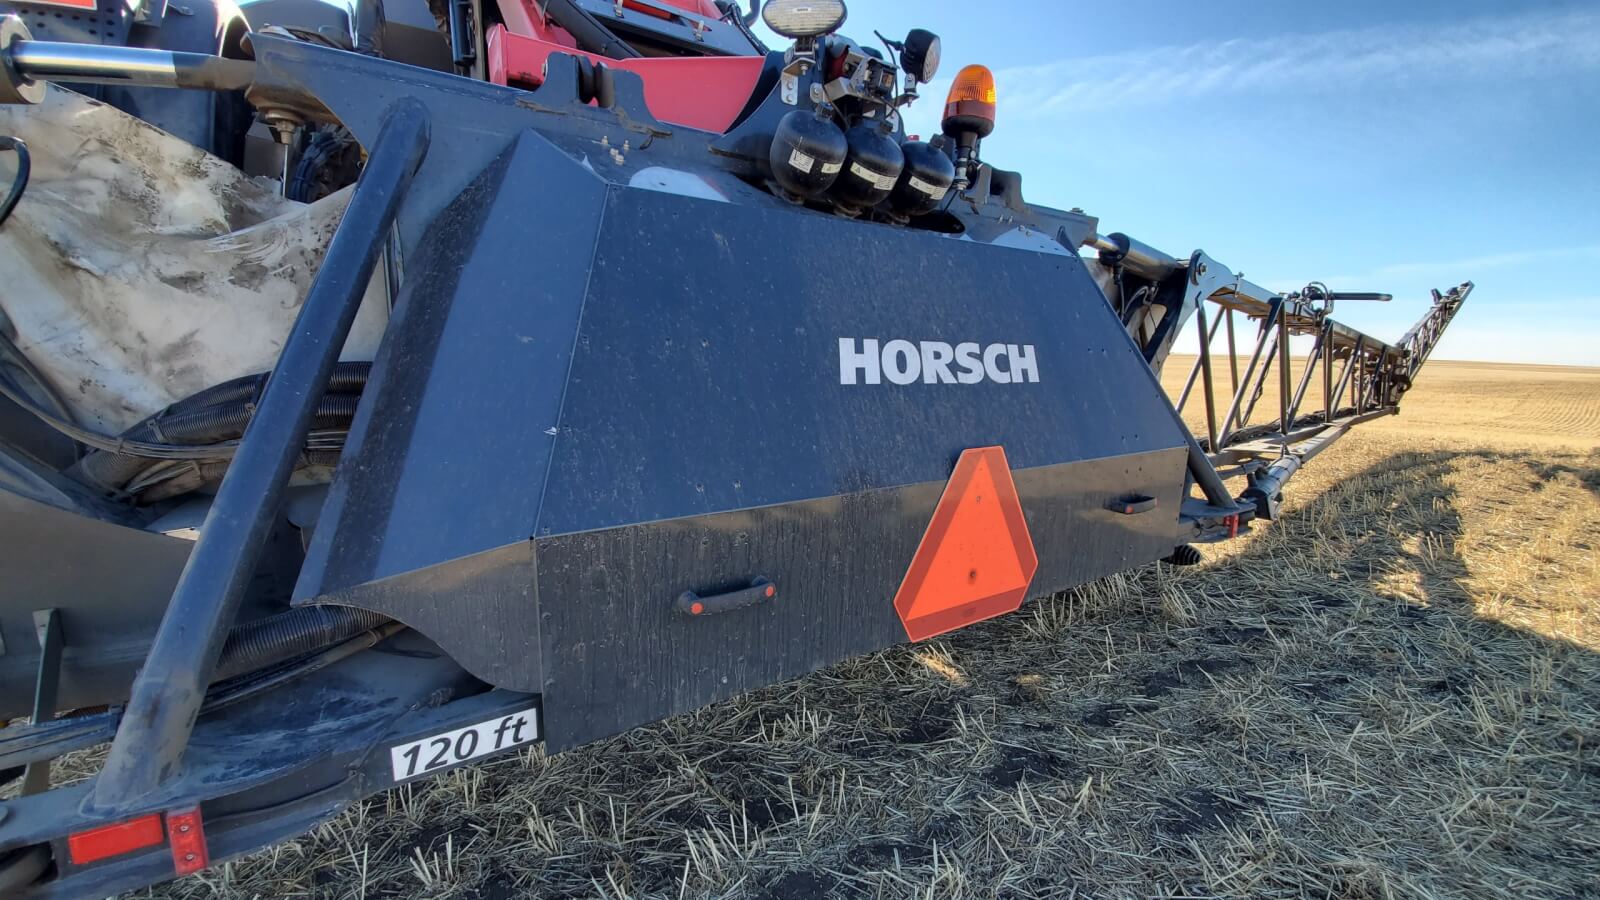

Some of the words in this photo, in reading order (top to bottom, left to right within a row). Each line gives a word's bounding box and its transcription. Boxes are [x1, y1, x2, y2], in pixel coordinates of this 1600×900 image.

[838, 337, 1040, 385] HORSCH
[402, 729, 479, 776] 120
[494, 715, 528, 750] ft
